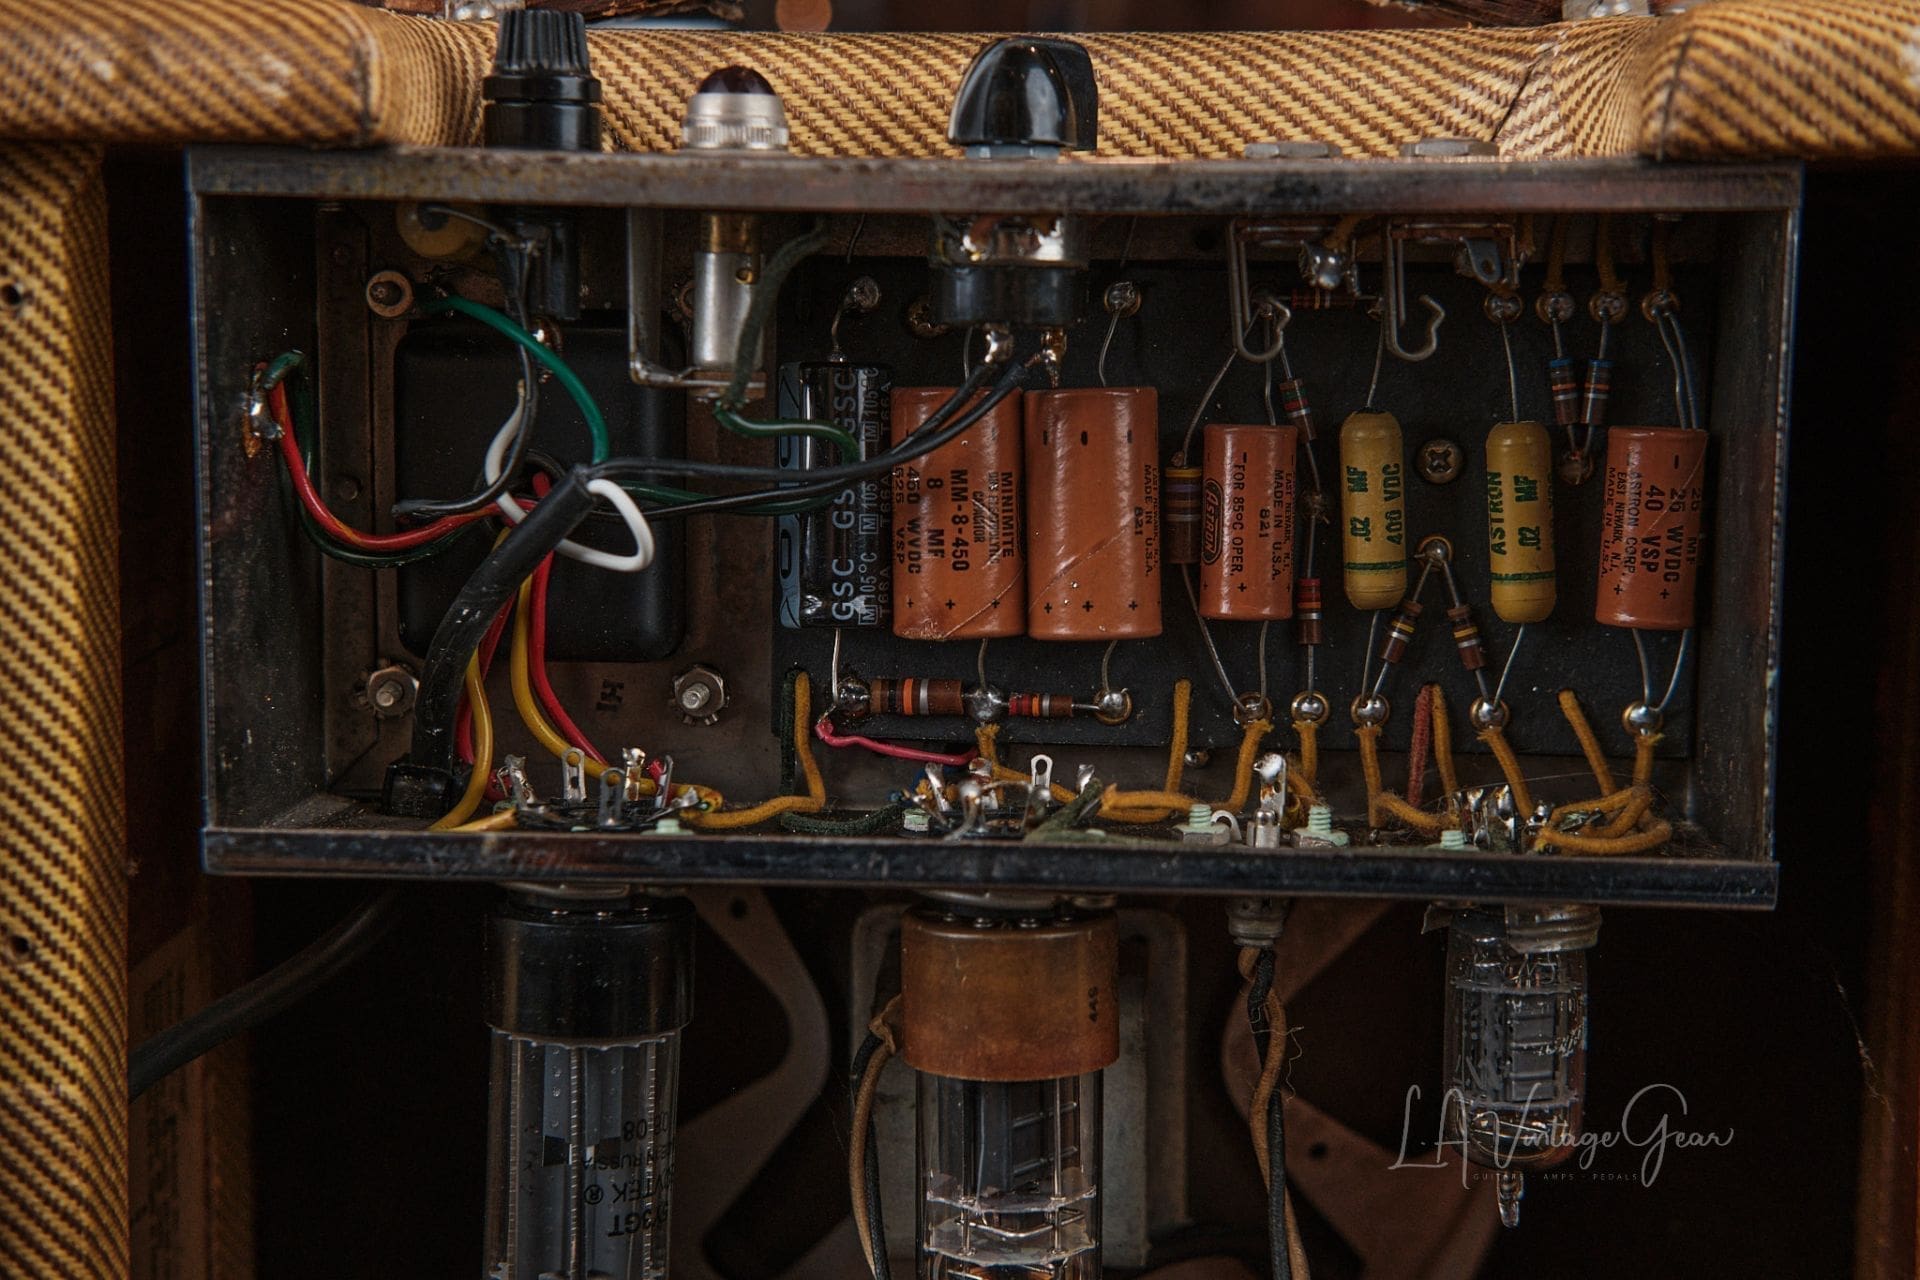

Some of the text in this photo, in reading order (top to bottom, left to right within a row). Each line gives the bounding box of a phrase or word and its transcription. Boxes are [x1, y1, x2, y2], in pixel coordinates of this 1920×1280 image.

[831, 370, 857, 622] GSC GS GSC
[1001, 471, 1015, 559] MINIMITE
[1232, 464, 1246, 491] FOR
[1284, 472, 1293, 496] EAST
[1346, 465, 1372, 543] .02 MF
[1381, 462, 1404, 546] 400 VDC
[1487, 471, 1507, 556] ASTRON
[1513, 474, 1542, 552] .02 MF
[1616, 471, 1627, 497] EAST
[1627, 470, 1643, 528] ASTRON
[895, 526, 906, 565] VSP
[907, 465, 921, 575] 450 WVDC
[926, 477, 945, 559] 8 MF
[951, 469, 970, 572] MM-8-450
[1133, 506, 1144, 537] 821
[1143, 464, 1154, 578] MADE IN U.S.A.
[1204, 489, 1220, 554] ASTRON
[1258, 508, 1271, 539] 821
[1271, 469, 1284, 582] MADE IN U.S.A.
[1600, 466, 1617, 579] MADE IN U.S.A.
[1640, 484, 1665, 574] 40 VSP
[1663, 525, 1684, 583] WVDC
